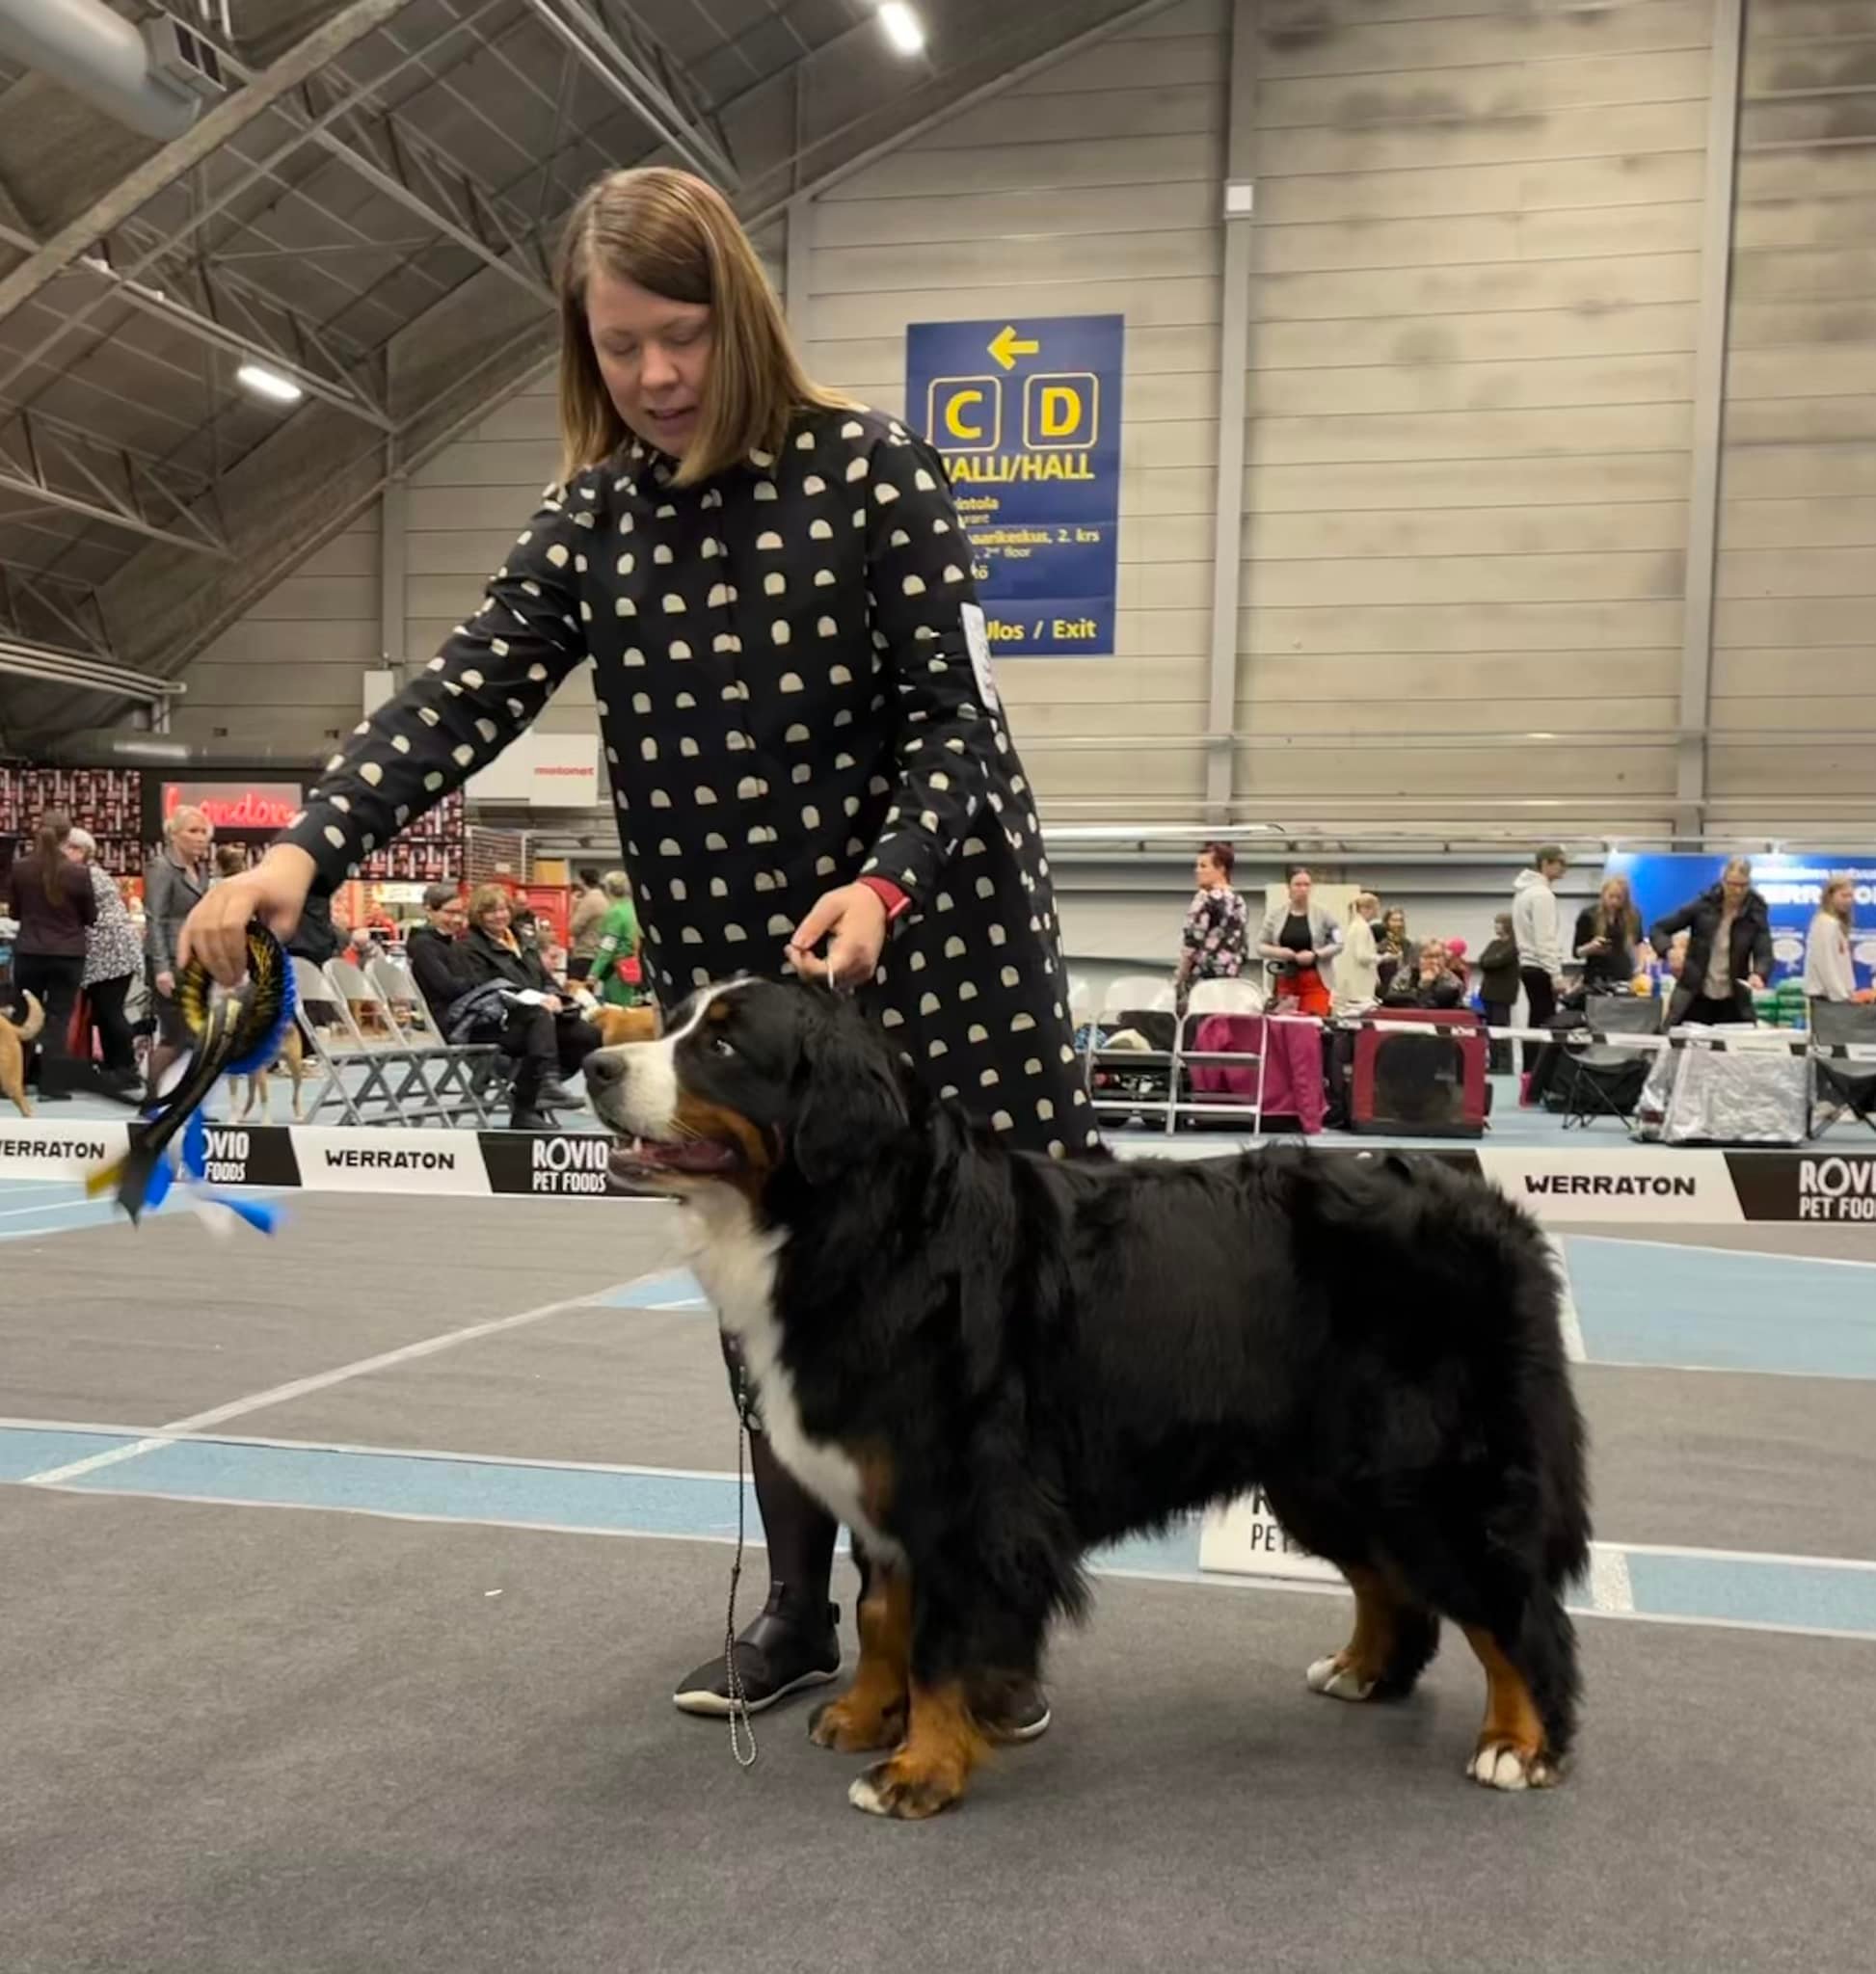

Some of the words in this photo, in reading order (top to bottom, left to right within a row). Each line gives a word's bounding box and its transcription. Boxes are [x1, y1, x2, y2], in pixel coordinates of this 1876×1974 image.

[945, 389, 983, 440] C
[1040, 387, 1082, 437] D
[1076, 527, 1100, 542] krs
[1053, 618, 1097, 639] Exit
[0, 1140, 105, 1159] ERRATON
[325, 1149, 455, 1169] WERRATON
[532, 1137, 609, 1171] ROVIO
[203, 1161, 246, 1182] FOODS
[532, 1171, 559, 1191] PET
[562, 1172, 606, 1193] FOODS
[1525, 1175, 1696, 1195] WERRATON
[1799, 1196, 1835, 1219] PET
[1839, 1196, 1876, 1220] FOO
